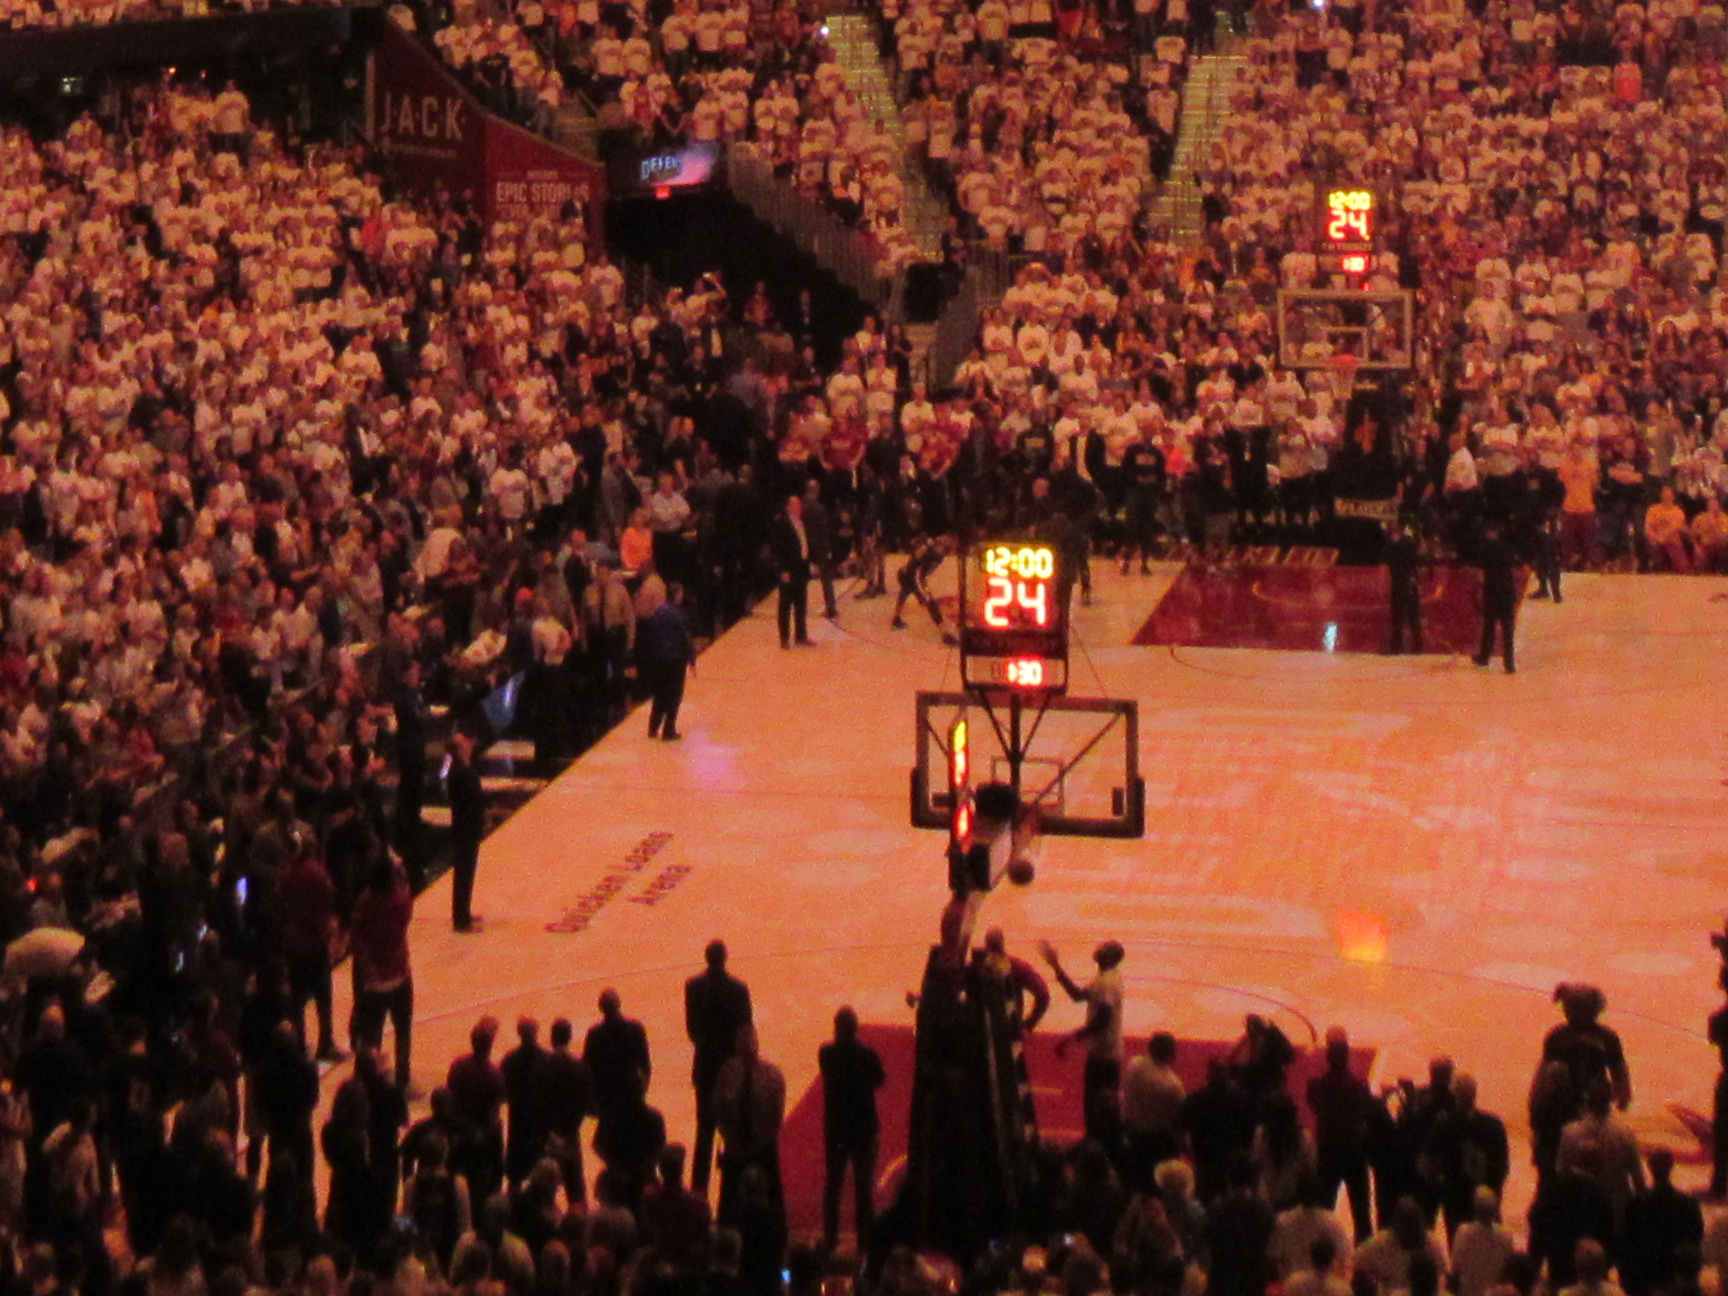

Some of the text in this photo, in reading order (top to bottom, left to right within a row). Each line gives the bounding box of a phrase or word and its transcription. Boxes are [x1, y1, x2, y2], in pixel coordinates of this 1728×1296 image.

[379, 92, 464, 142] JACK
[1328, 191, 1371, 210] 12:00
[1328, 209, 1368, 239] 24
[985, 546, 1055, 579] 12:00
[983, 577, 1047, 627] 24
[1007, 660, 1043, 686] 1:30
